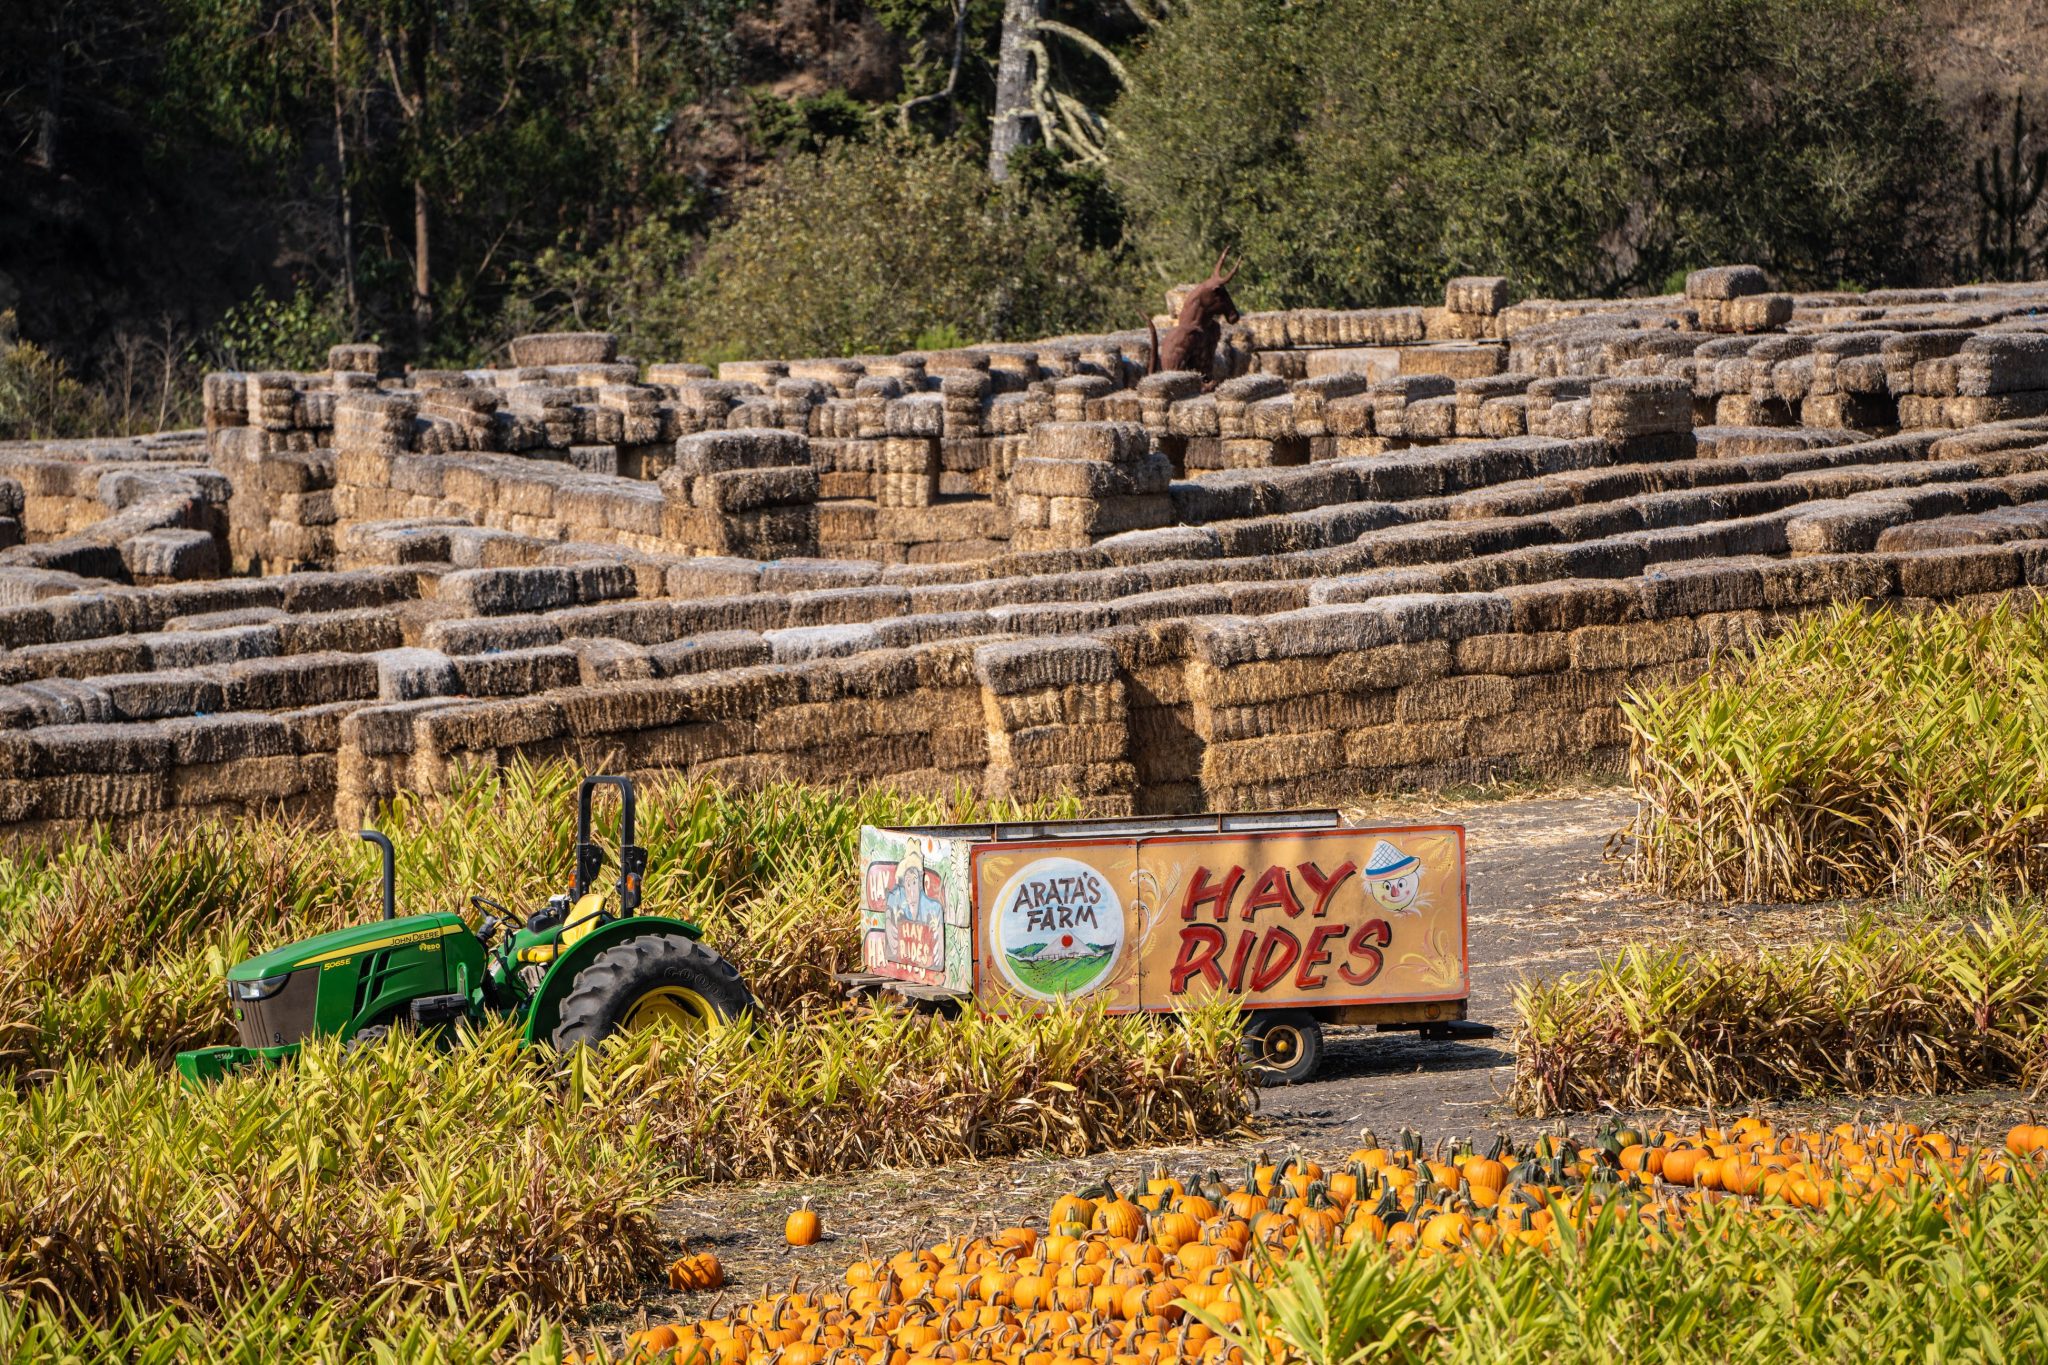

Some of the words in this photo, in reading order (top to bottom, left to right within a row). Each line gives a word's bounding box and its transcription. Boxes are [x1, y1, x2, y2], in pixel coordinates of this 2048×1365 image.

[869, 871, 890, 901] HAY
[1013, 872, 1101, 912] ARATA'S
[1181, 861, 1357, 922] HAY
[902, 924, 923, 941] HAY
[1027, 905, 1098, 932] FARM
[391, 937, 412, 946] JOHN
[413, 931, 440, 941] DEERE
[868, 936, 888, 969] HA
[900, 941, 929, 964] RIDES
[323, 958, 351, 970] 5065E
[1170, 918, 1392, 995] RIDES
